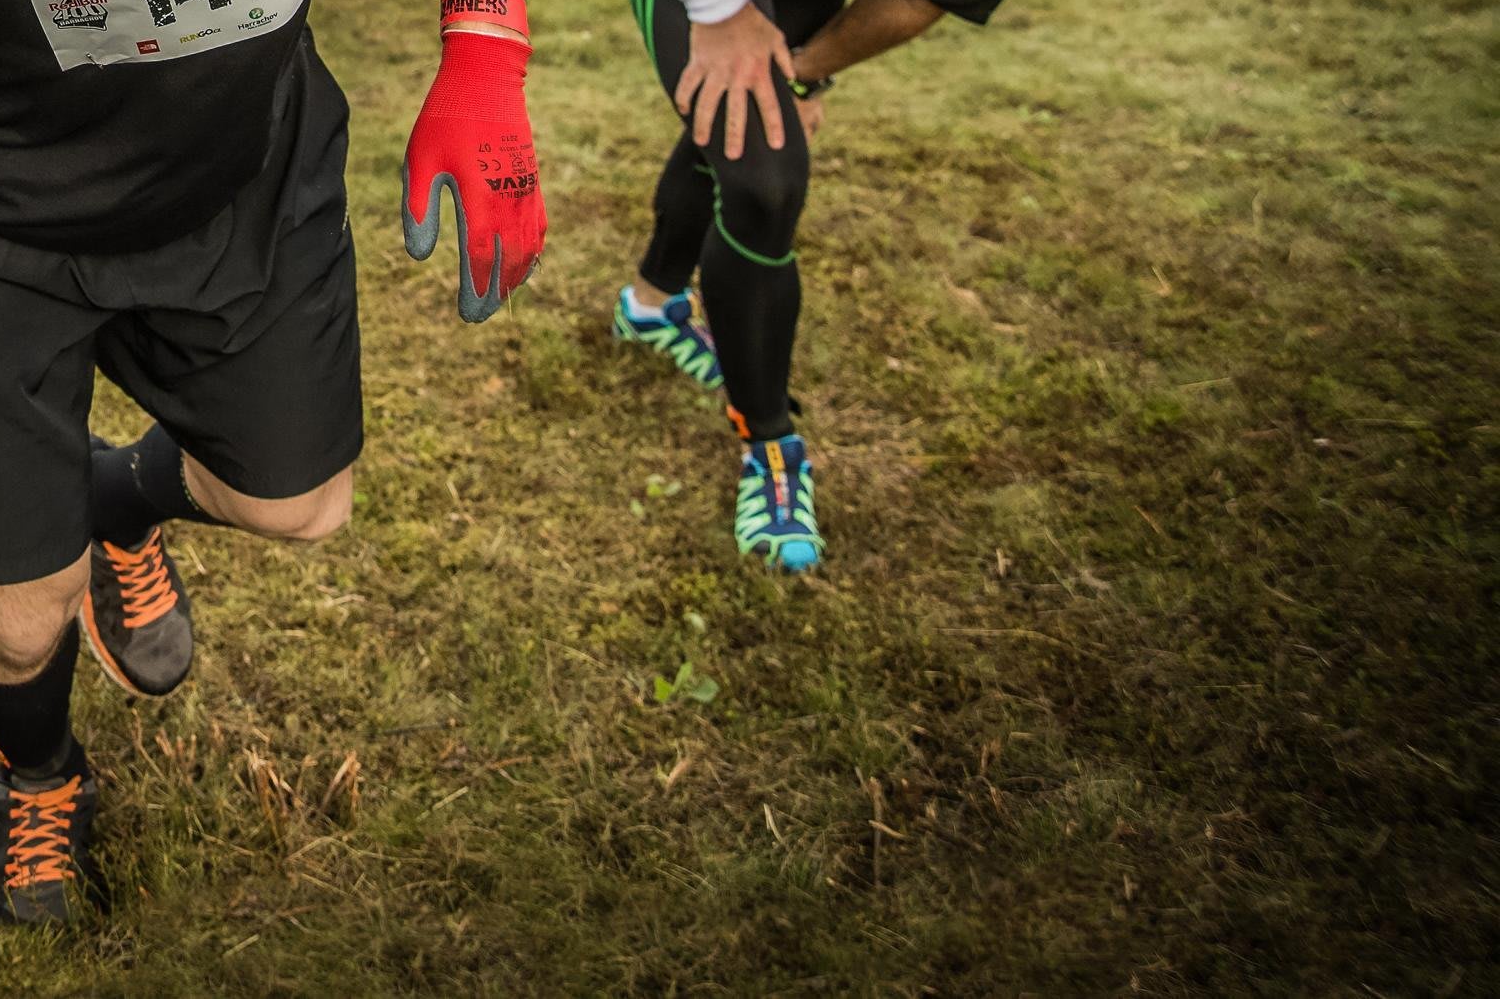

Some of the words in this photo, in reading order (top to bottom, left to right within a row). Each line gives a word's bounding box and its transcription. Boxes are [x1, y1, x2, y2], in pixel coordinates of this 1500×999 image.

[53, 4, 107, 21] 400
[59, 15, 104, 27] HARRACHOV
[237, 12, 279, 31] Harrachov
[484, 170, 539, 191] ERVA
